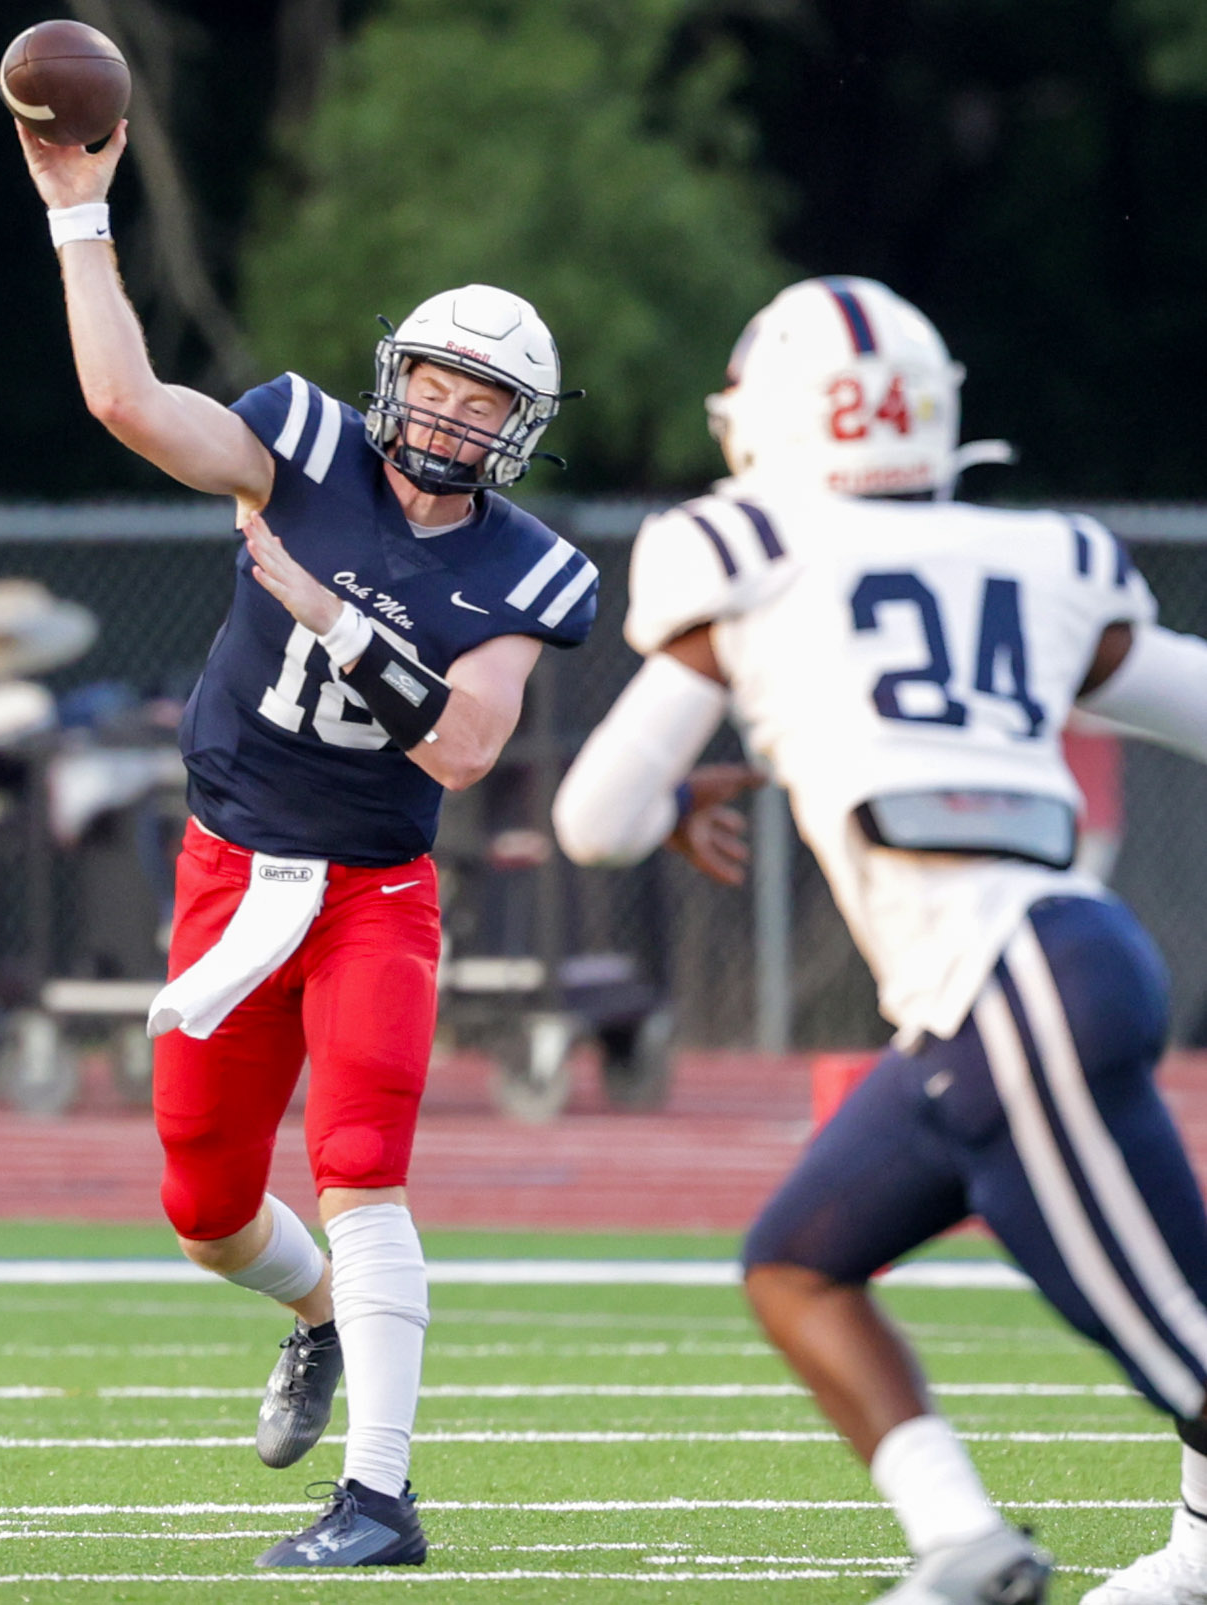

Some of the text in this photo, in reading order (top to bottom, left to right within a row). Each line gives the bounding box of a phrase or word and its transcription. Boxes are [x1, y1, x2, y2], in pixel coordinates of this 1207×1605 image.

[826, 373, 911, 442] 24
[333, 571, 415, 630] Oak Mtn
[850, 571, 1047, 738] 24
[264, 868, 308, 880] BATTLE
